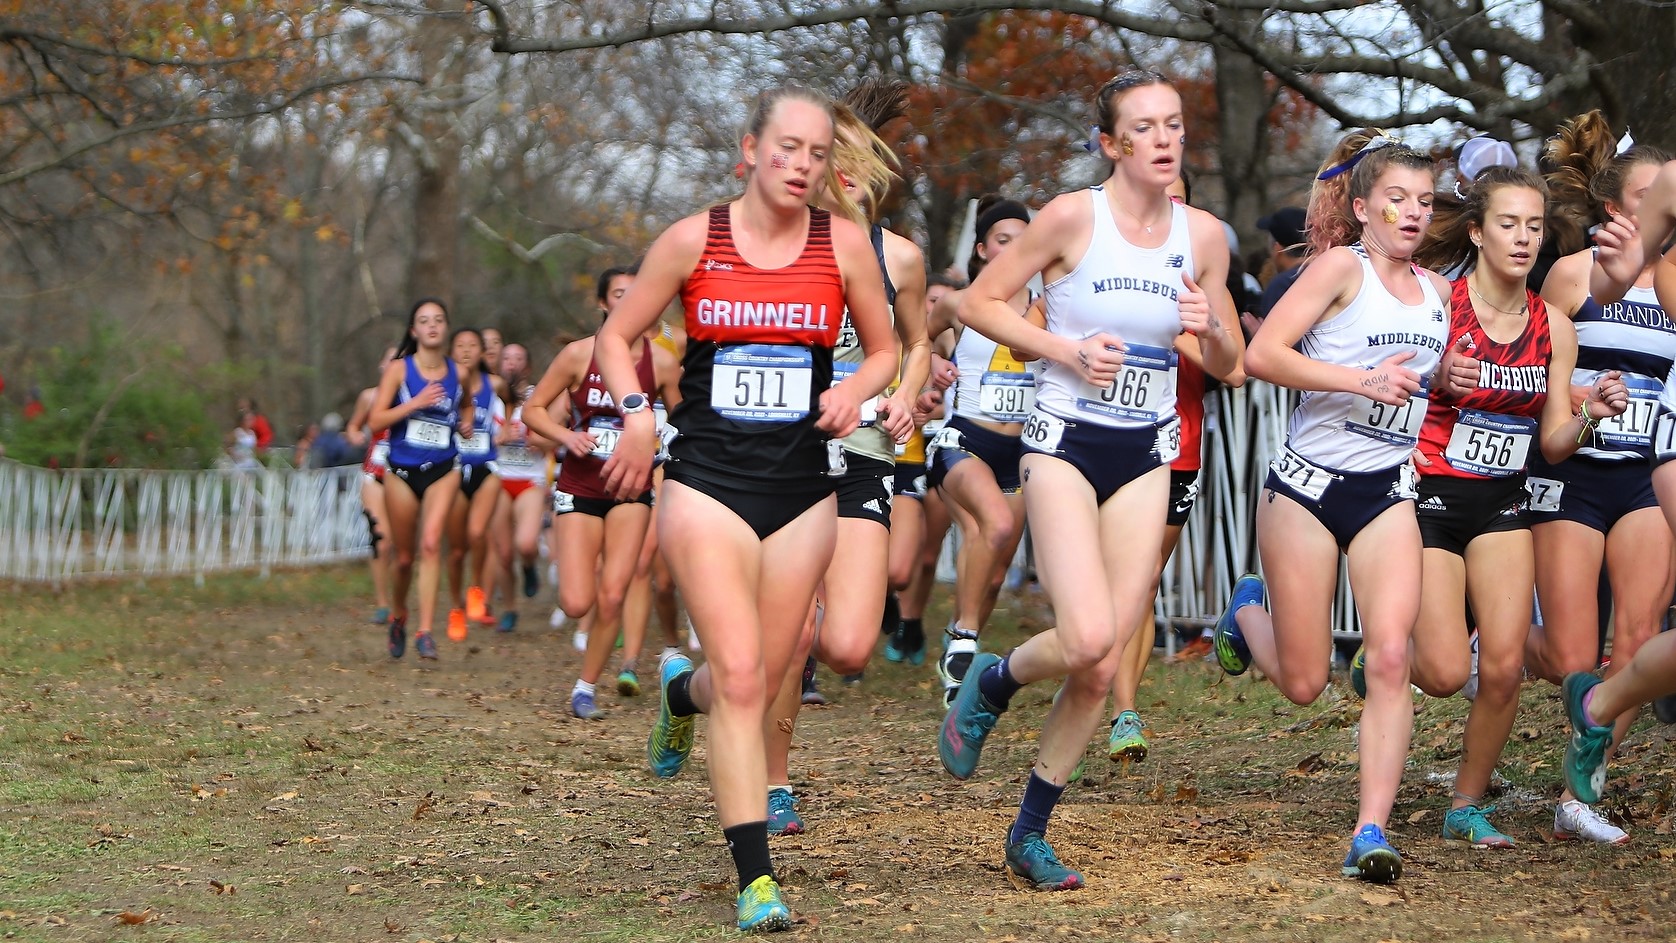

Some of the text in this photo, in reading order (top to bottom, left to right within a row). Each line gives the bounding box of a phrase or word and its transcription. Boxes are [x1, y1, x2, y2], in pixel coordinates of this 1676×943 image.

[1092, 277, 1178, 302] MIDDLEBUR
[697, 298, 829, 330] GRINNELL
[1602, 302, 1676, 332] BRANDE
[1367, 332, 1444, 356] MIDDLEBUR
[734, 369, 788, 407] 511
[1101, 368, 1151, 407] 566
[1479, 360, 1547, 393] NCHBURG
[994, 387, 1025, 412] 391
[1368, 399, 1413, 433] 571
[1611, 401, 1653, 434] 417
[1464, 429, 1515, 467] 556
[1280, 452, 1316, 487] 571
